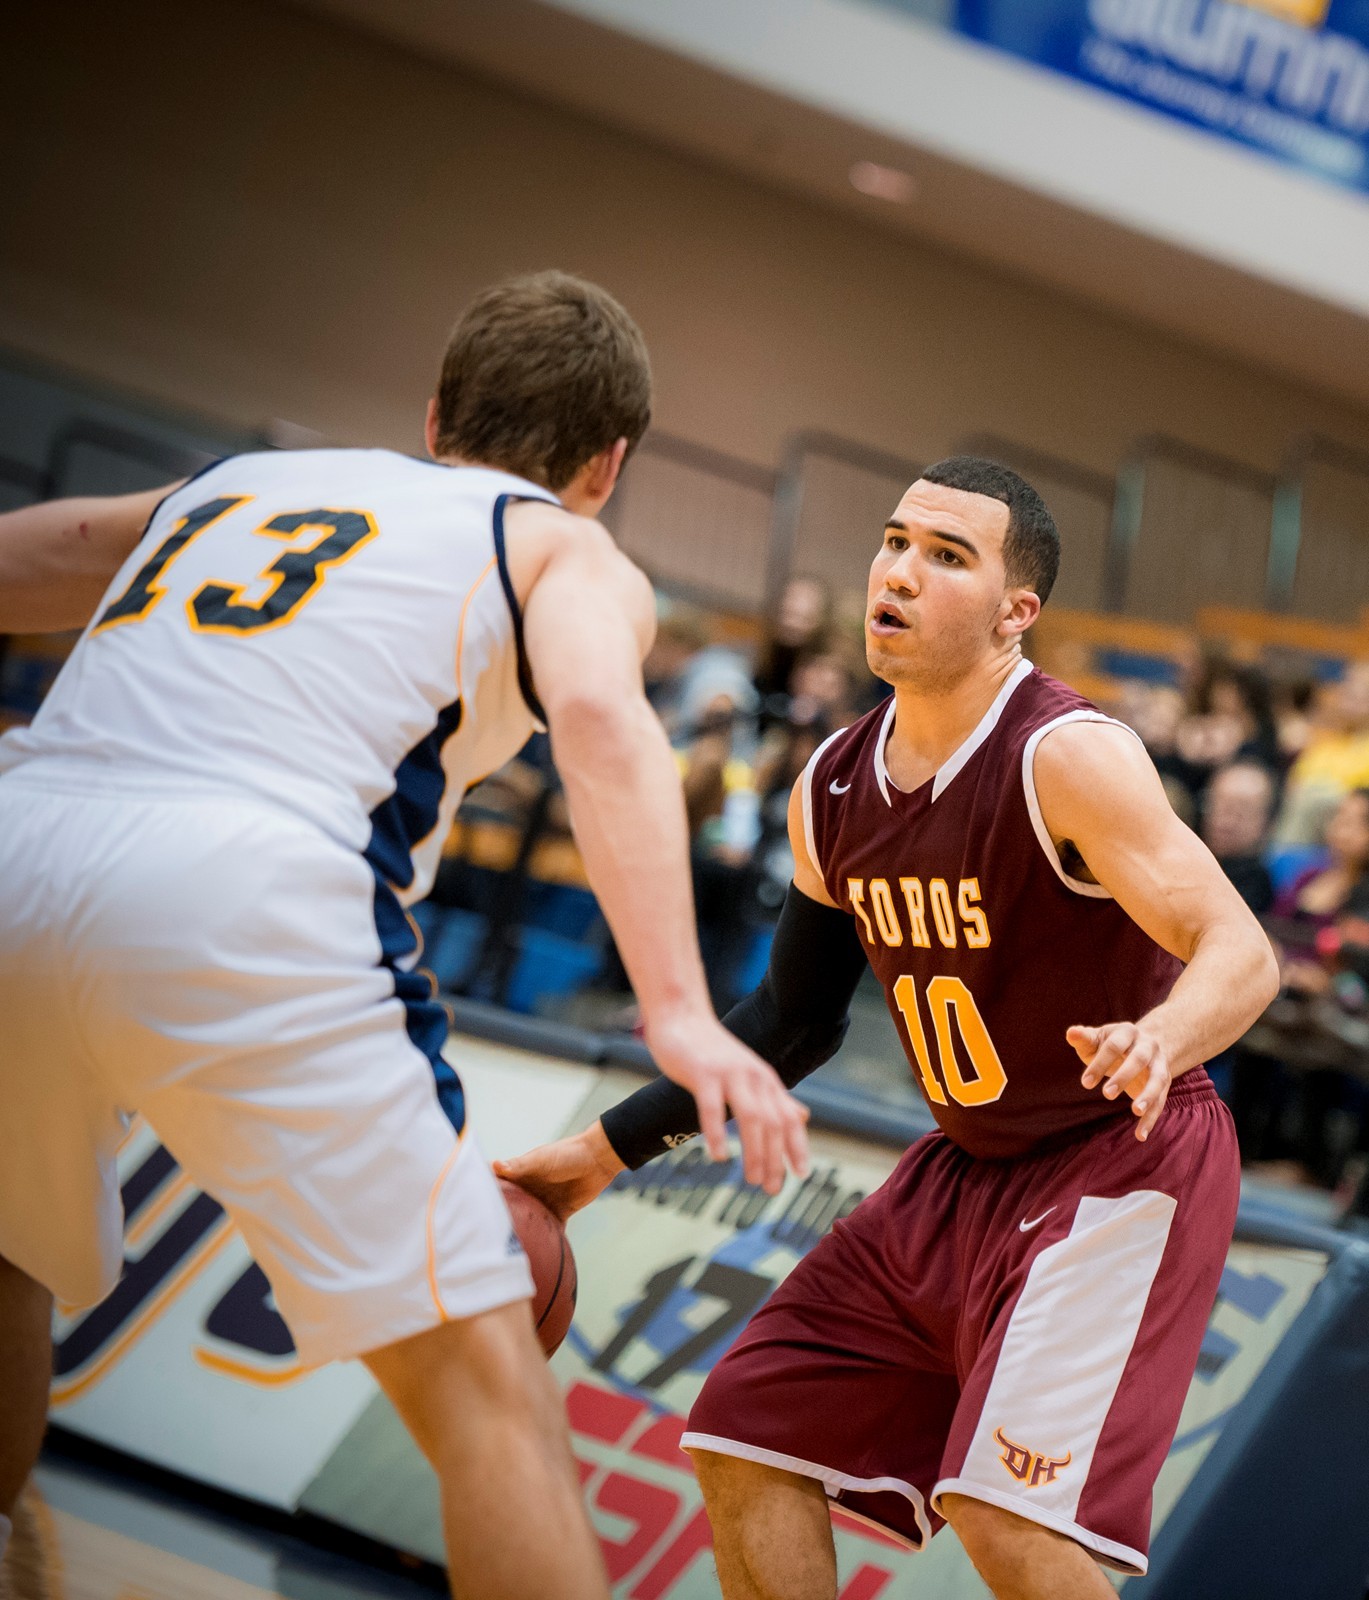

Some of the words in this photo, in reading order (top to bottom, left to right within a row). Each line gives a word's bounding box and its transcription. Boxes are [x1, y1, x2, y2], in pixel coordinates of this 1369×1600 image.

[88, 494, 381, 638] 13
[847, 877, 991, 949] TOROS
[893, 974, 1009, 1108] 10
[992, 1425, 1072, 1489] DH
